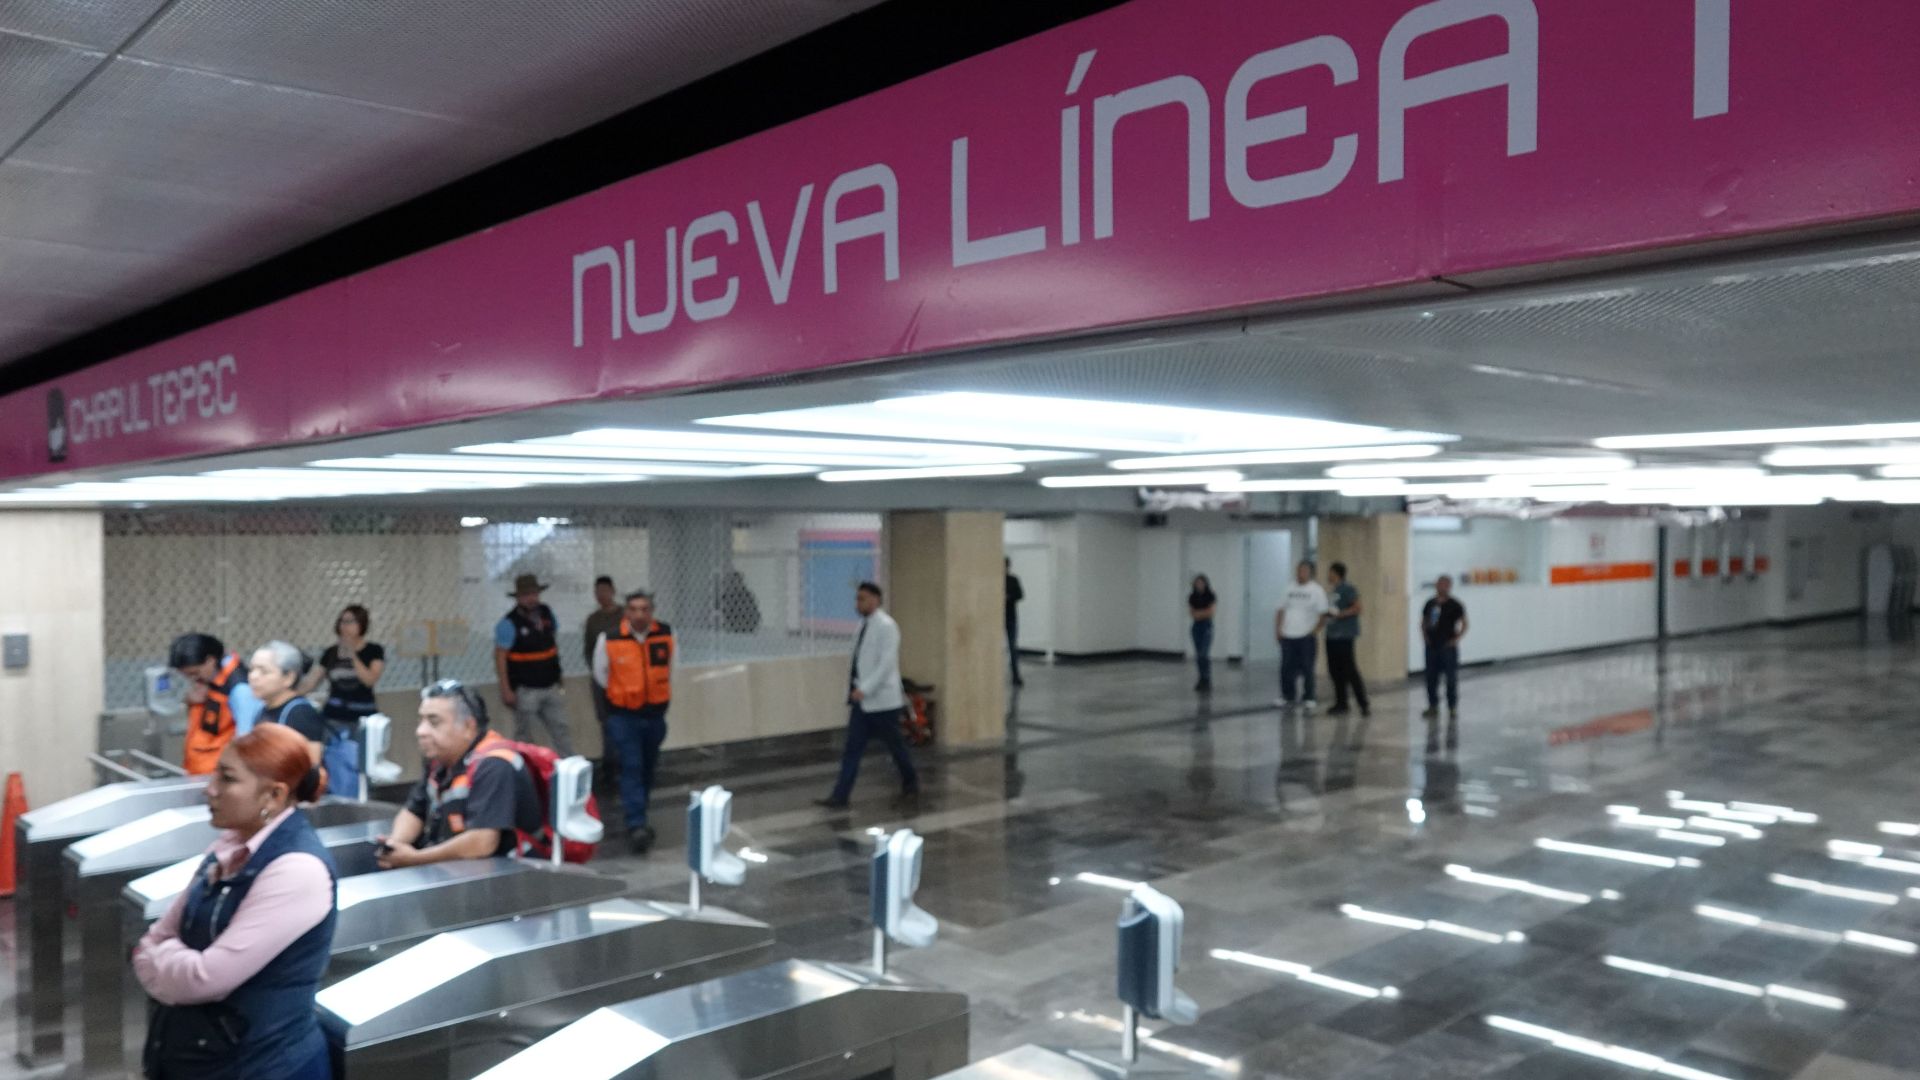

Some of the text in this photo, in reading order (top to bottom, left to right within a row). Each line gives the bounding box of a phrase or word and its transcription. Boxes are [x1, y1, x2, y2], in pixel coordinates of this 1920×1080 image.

[572, 163, 899, 347] NUEVA
[952, 0, 1539, 267] LÍNEA
[69, 354, 238, 444] CHAPULTEPEC
